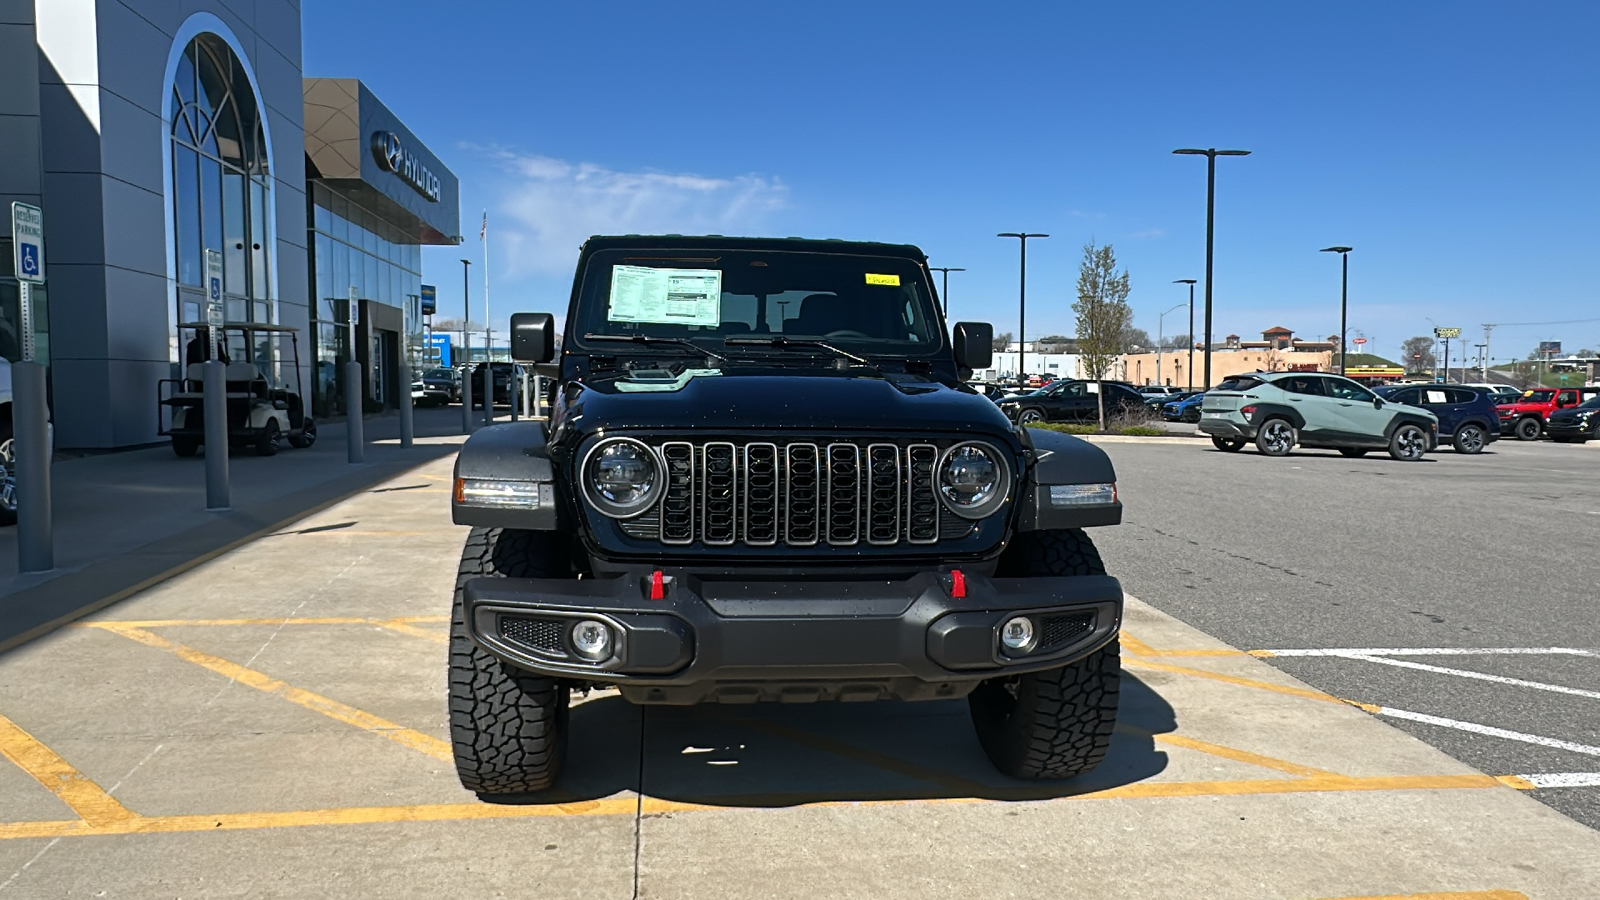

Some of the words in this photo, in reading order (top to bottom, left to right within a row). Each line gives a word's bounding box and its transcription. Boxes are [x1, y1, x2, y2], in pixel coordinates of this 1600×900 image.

[404, 149, 440, 201] HYUNDAI
[16, 210, 39, 225] RESERVED
[17, 223, 40, 237] PARKING
